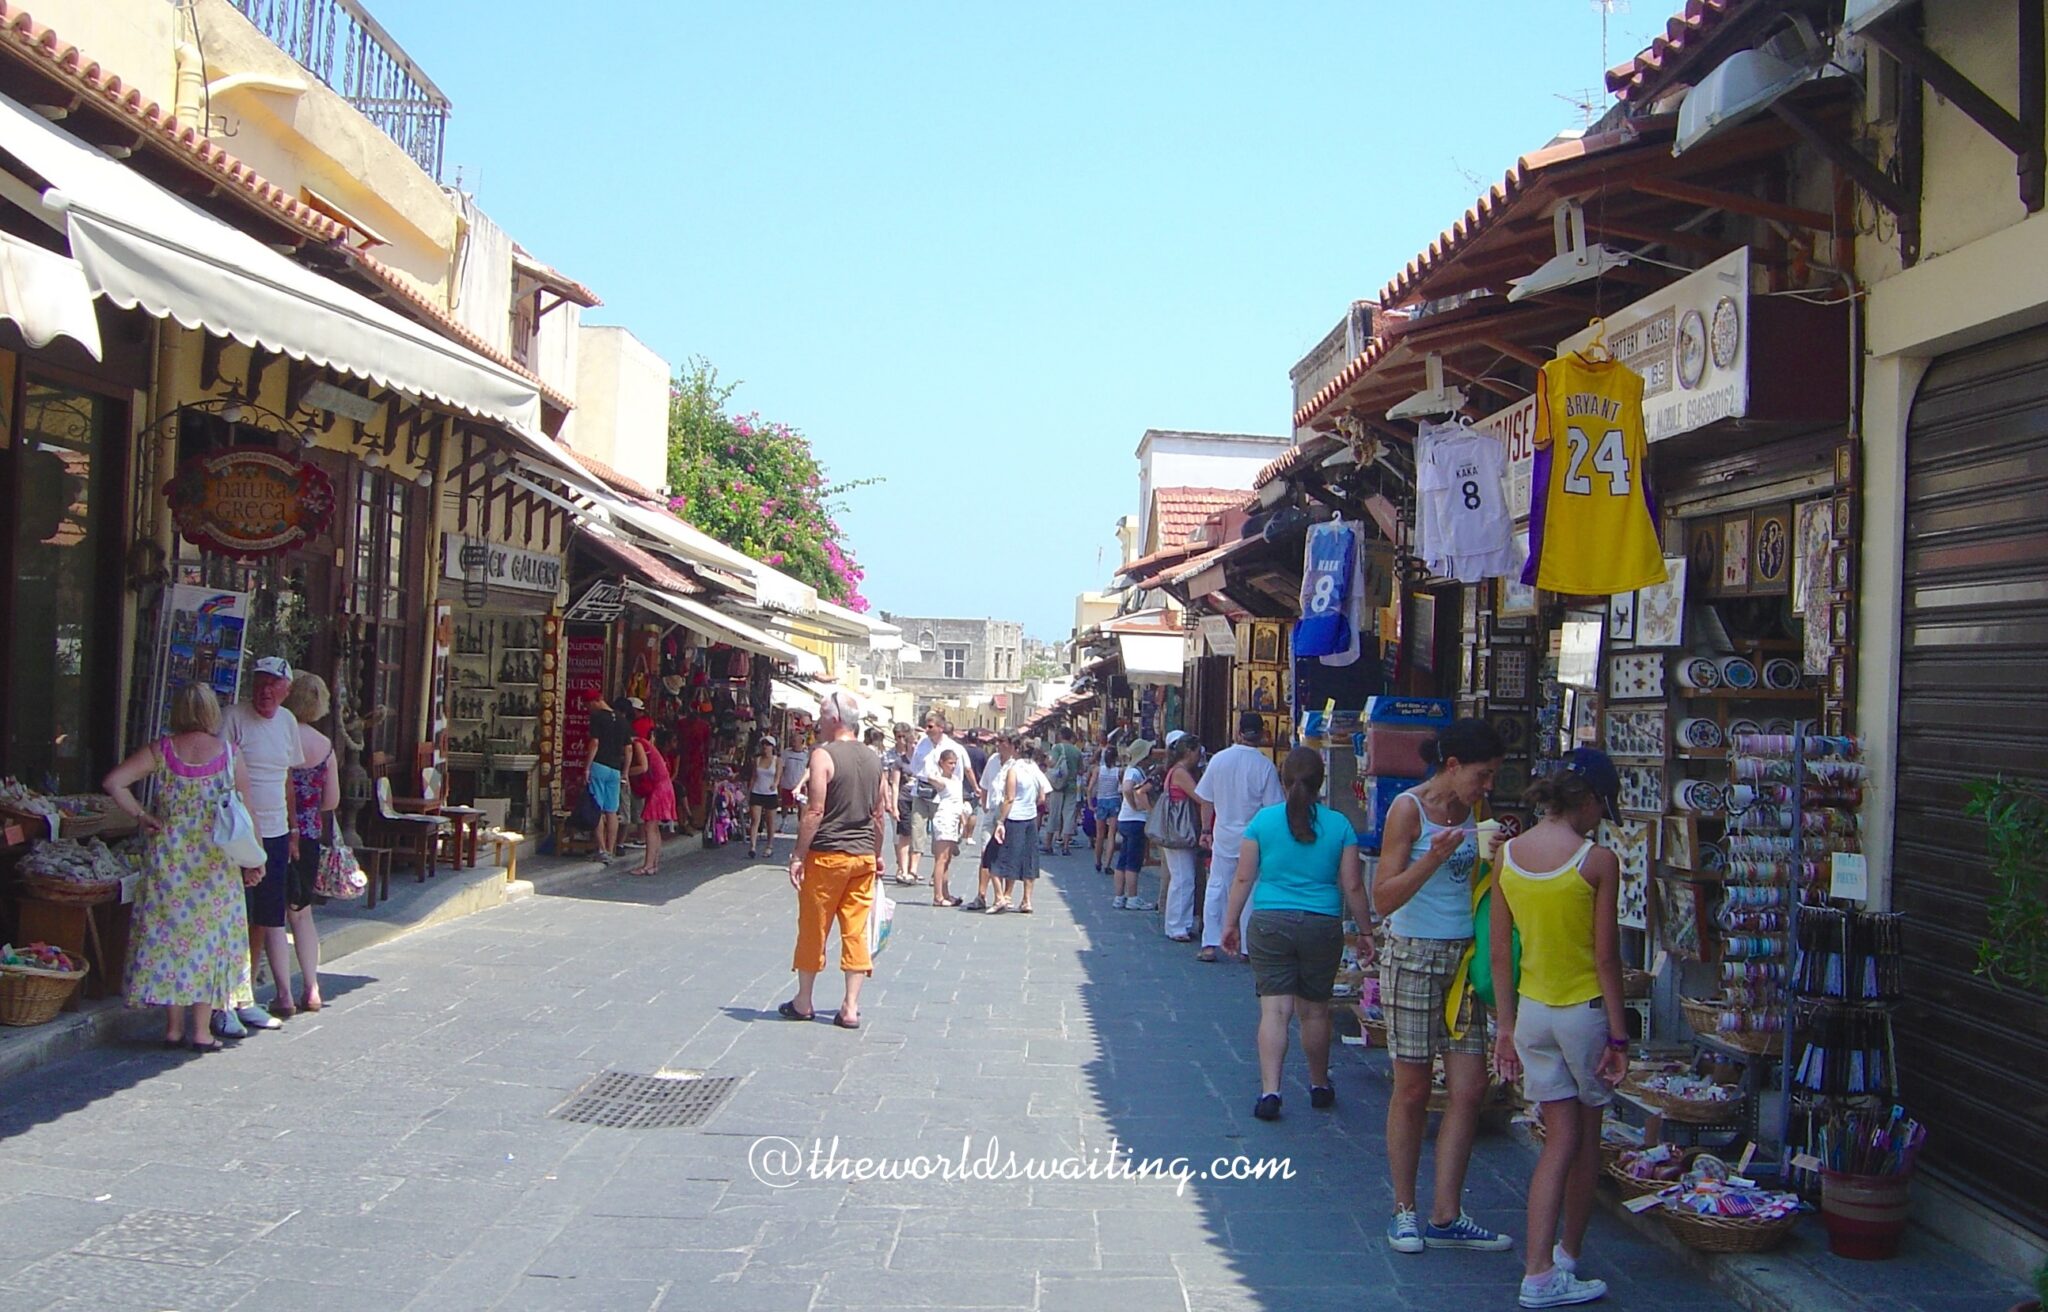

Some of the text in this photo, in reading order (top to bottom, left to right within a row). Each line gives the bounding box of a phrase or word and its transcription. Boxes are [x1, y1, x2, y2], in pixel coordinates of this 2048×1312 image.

[1646, 318, 1669, 346] HOUSE
[1565, 393, 1621, 423] BRYANT
[1490, 403, 1534, 462] USE
[1563, 425, 1631, 497] 24
[1462, 480, 1482, 510] 8
[1310, 574, 1335, 613] 8
[568, 642, 604, 651] OLLECTION
